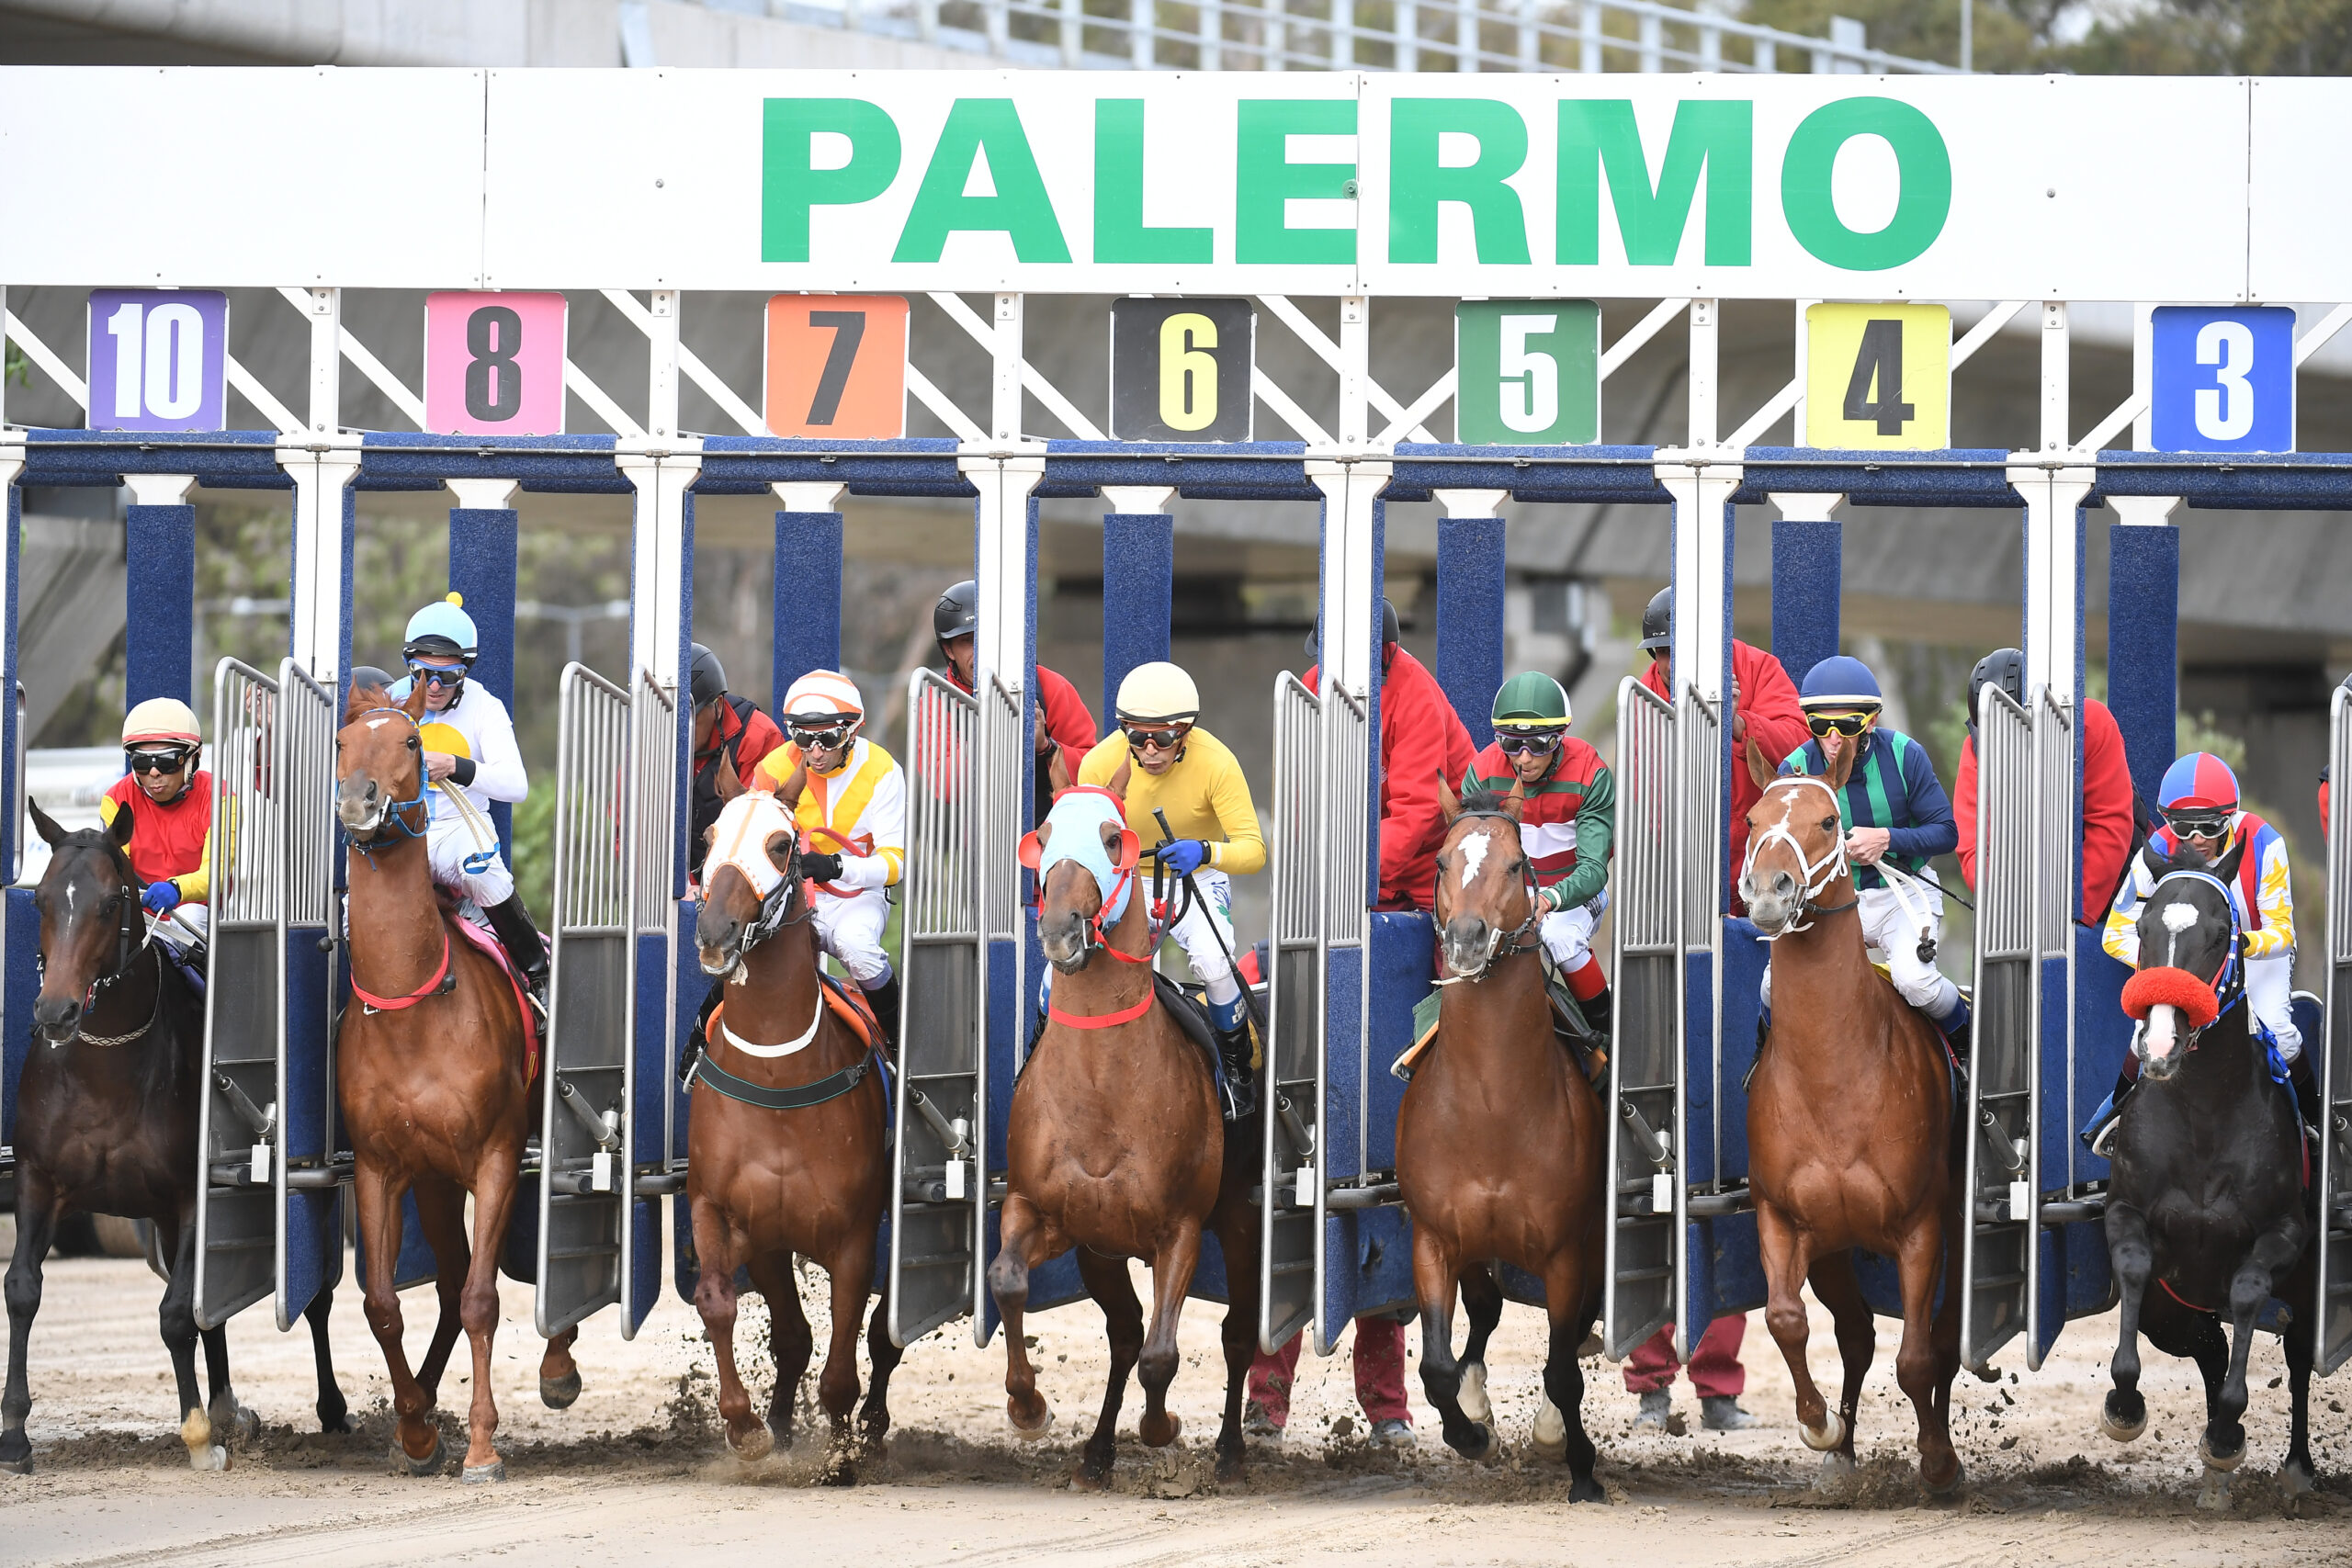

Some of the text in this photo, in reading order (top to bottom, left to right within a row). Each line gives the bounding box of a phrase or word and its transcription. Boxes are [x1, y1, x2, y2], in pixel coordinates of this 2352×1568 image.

[762, 96, 1952, 272] PALERMO
[107, 303, 204, 420] 10
[466, 306, 523, 423] 8
[806, 310, 866, 425] 7
[1159, 312, 1218, 432] 6
[1499, 314, 1559, 434] 5
[1842, 319, 1915, 436] 4
[2195, 321, 2255, 441] 3
